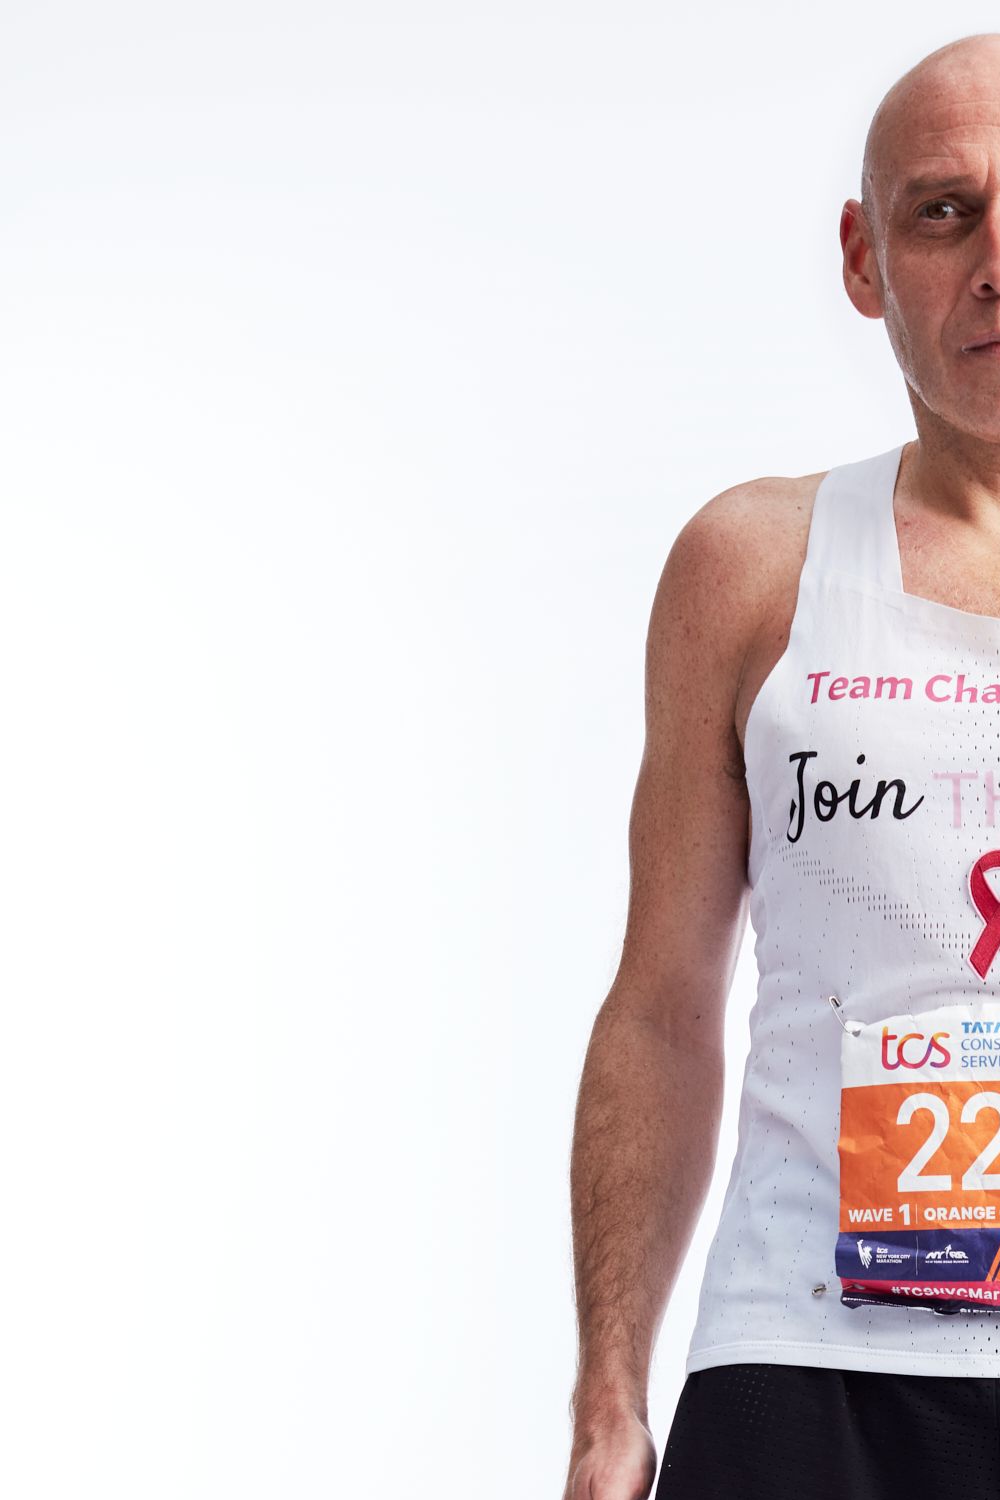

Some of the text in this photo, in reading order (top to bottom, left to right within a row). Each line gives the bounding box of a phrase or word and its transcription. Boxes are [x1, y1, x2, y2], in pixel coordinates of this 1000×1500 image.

[807, 671, 914, 704] Team
[786, 750, 925, 843] Join
[881, 1026, 951, 1071] tcs
[848, 1208, 893, 1223] WAVE
[898, 1203, 911, 1226] 1
[924, 1206, 996, 1221] ORANGE
